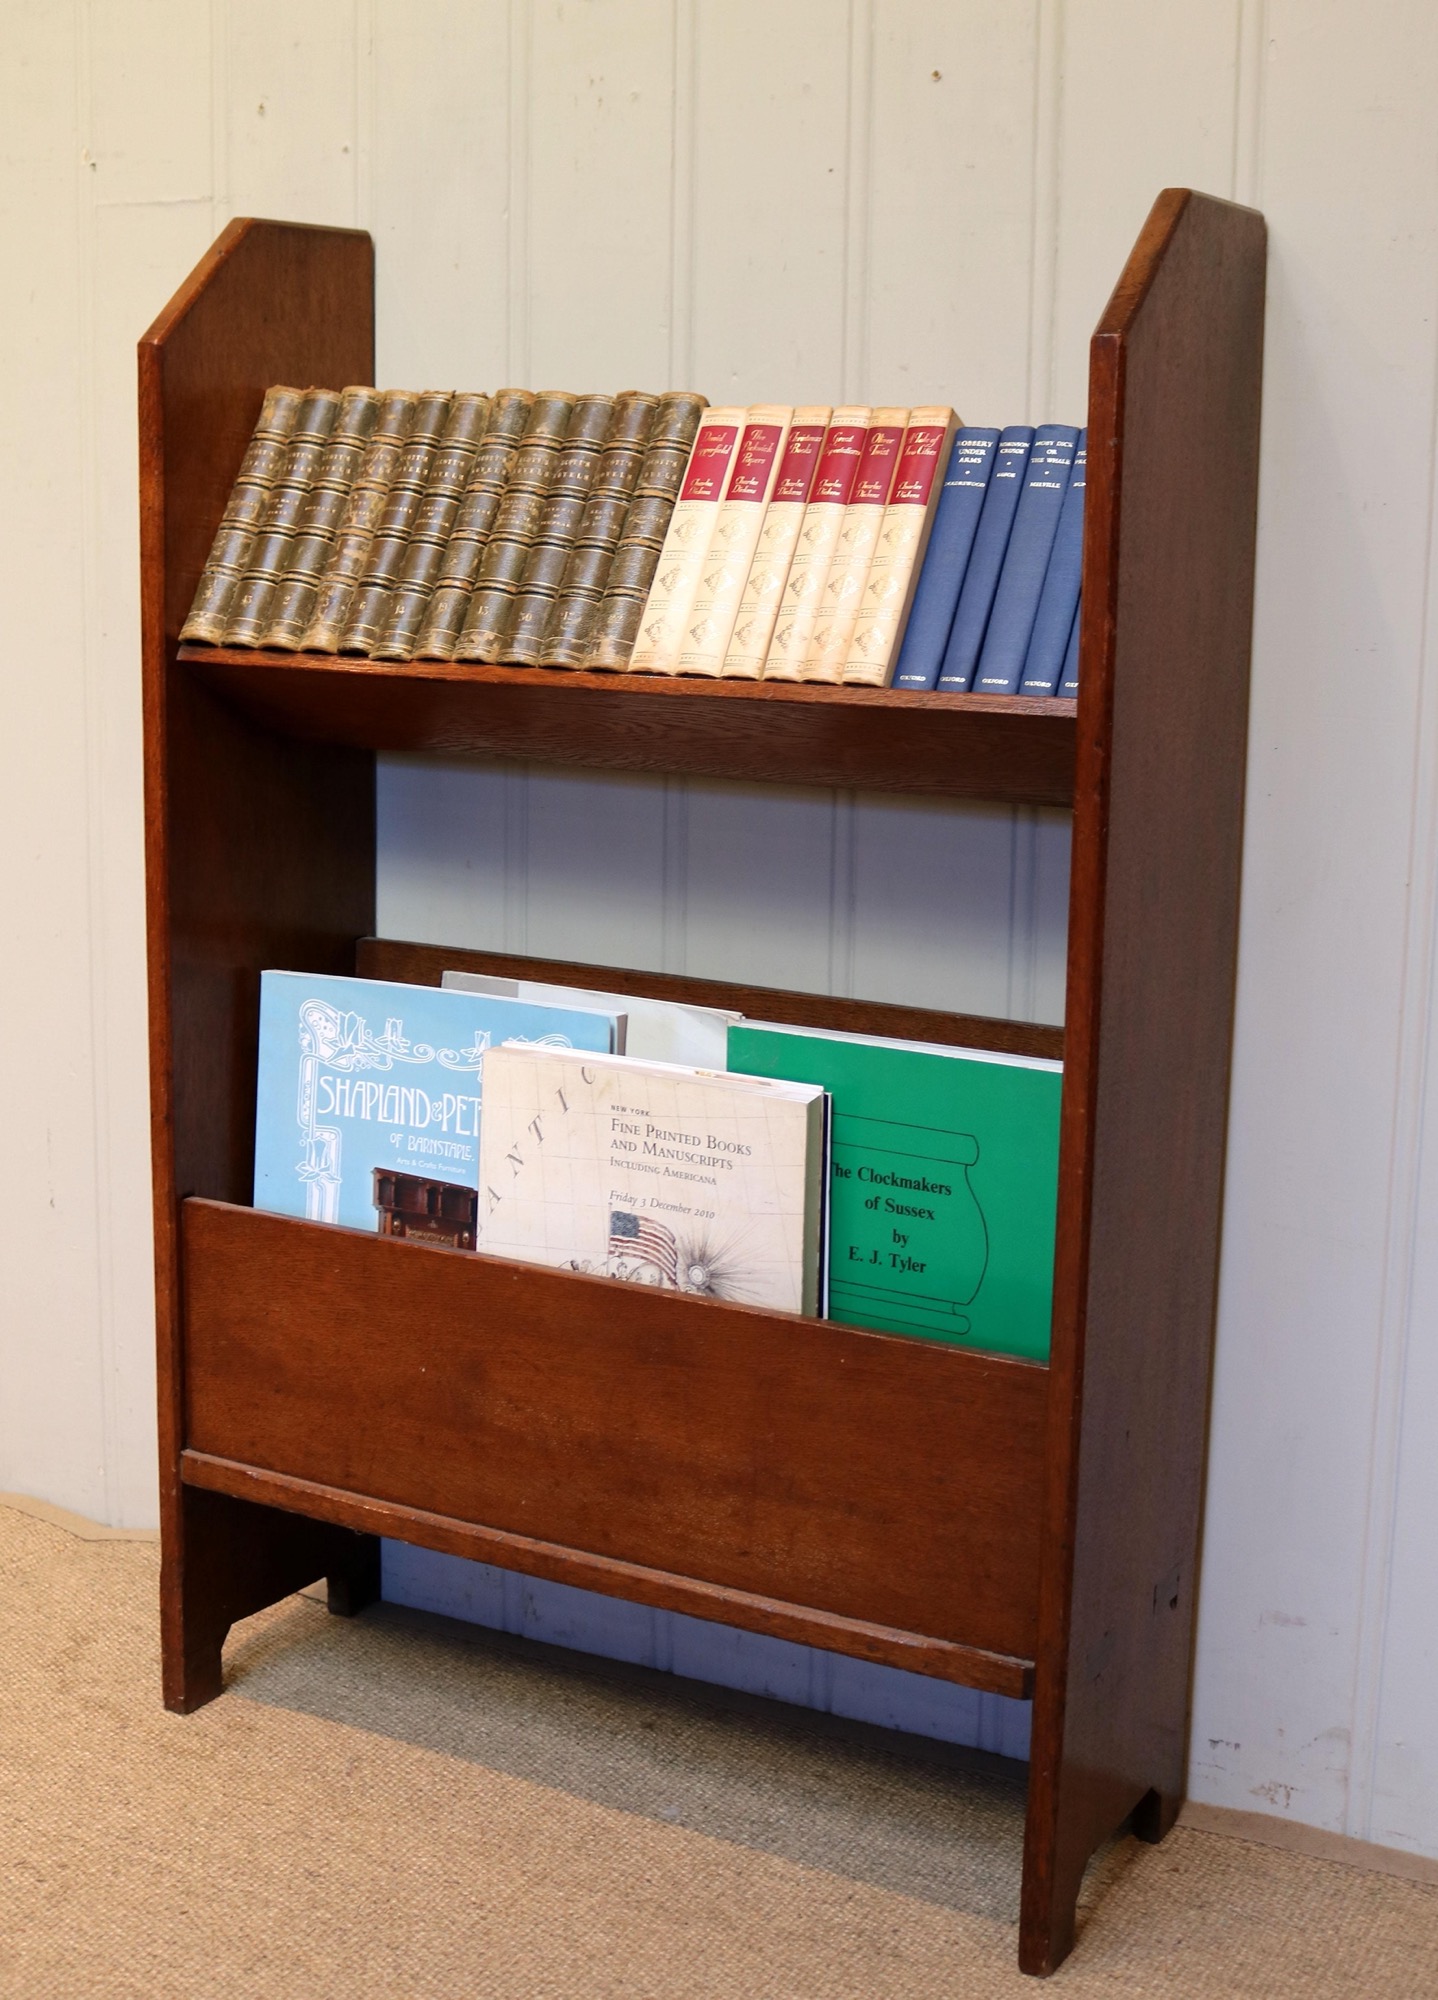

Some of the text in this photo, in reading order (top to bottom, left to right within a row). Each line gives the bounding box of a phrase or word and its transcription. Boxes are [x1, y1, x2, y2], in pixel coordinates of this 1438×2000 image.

[958, 448, 987, 456] UNDER
[317, 1075, 431, 1129] SHAPLAND
[611, 1104, 650, 1117] NEW YORK
[389, 1132, 404, 1148] OF
[611, 1118, 752, 1156] FINE PRINTED BOOKS
[396, 1157, 410, 1167] Arts
[418, 1160, 438, 1170] Crafts
[610, 1139, 733, 1170] AND MANUSCRIPTS
[610, 1156, 717, 1186] INCLUDING AMERICANA
[857, 1166, 952, 1195] Clockmakers
[609, 1190, 715, 1219] Friday 3 December 2010
[864, 1196, 935, 1220] of Sussex
[892, 1228, 909, 1248] by
[848, 1245, 927, 1273] E. J. Tyler
